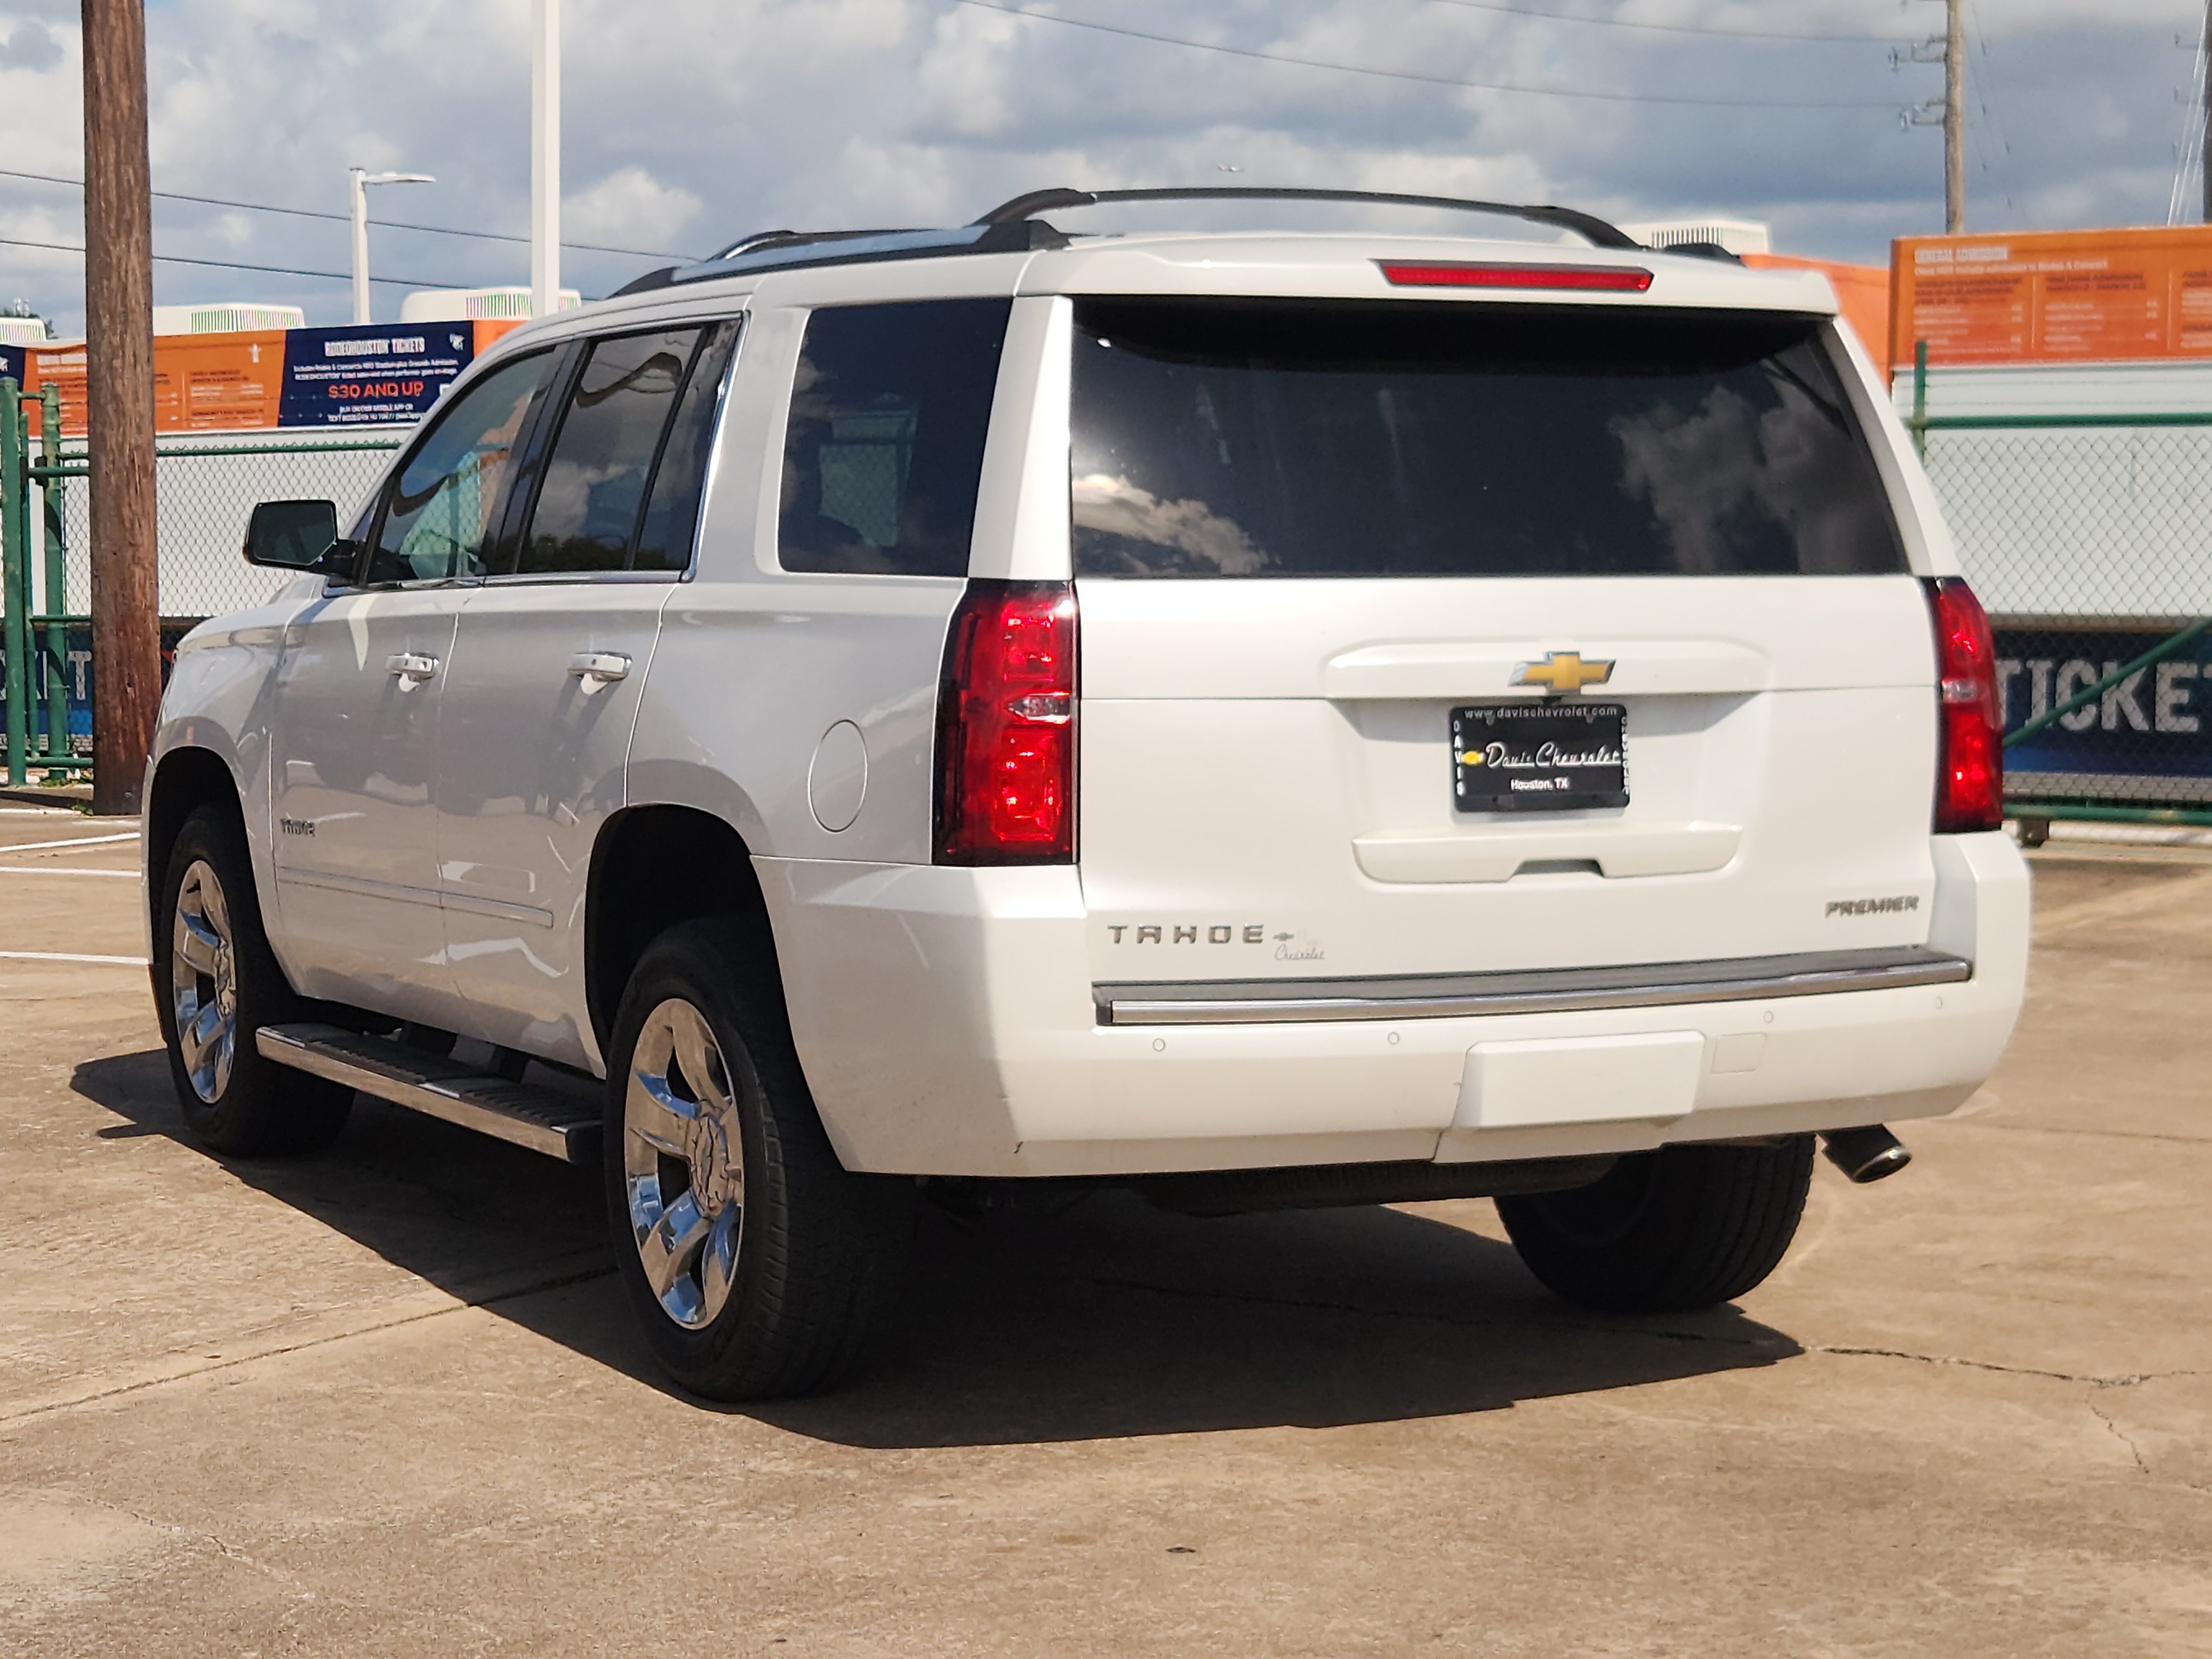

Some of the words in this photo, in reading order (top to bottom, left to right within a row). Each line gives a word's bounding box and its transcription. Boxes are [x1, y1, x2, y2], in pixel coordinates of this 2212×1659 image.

[364, 382, 399, 398] AND
[402, 381, 424, 397] UP
[1994, 659, 2212, 732] TICKE
[1536, 742, 1621, 767] Chevrolet
[1554, 776, 1569, 790] TX
[1825, 896, 1919, 919] PREMIER
[1107, 923, 1263, 944] TAHOE
